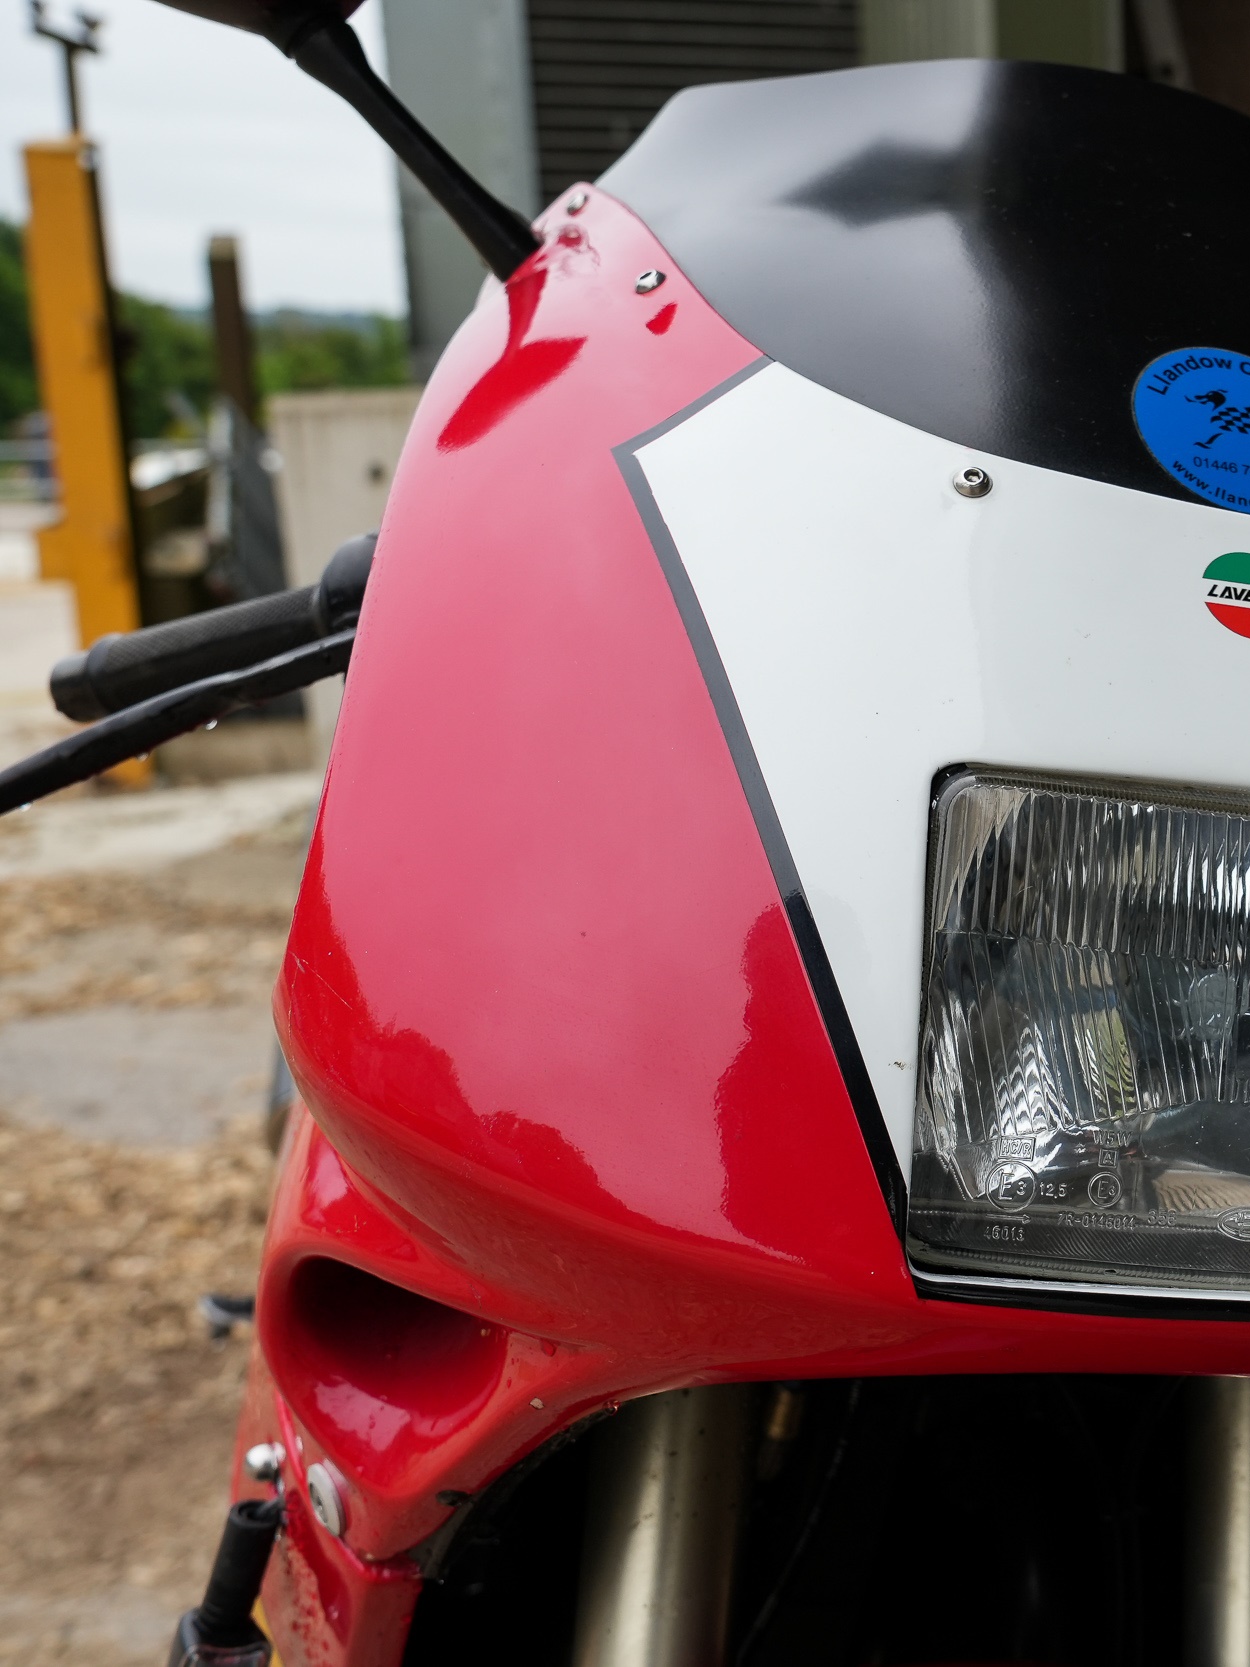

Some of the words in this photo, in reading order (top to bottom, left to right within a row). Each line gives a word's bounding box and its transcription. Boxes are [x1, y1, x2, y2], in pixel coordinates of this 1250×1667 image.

[1147, 355, 1232, 396] Llandow
[1193, 456, 1238, 474] 01446
[1092, 1130, 1133, 1147] W5W
